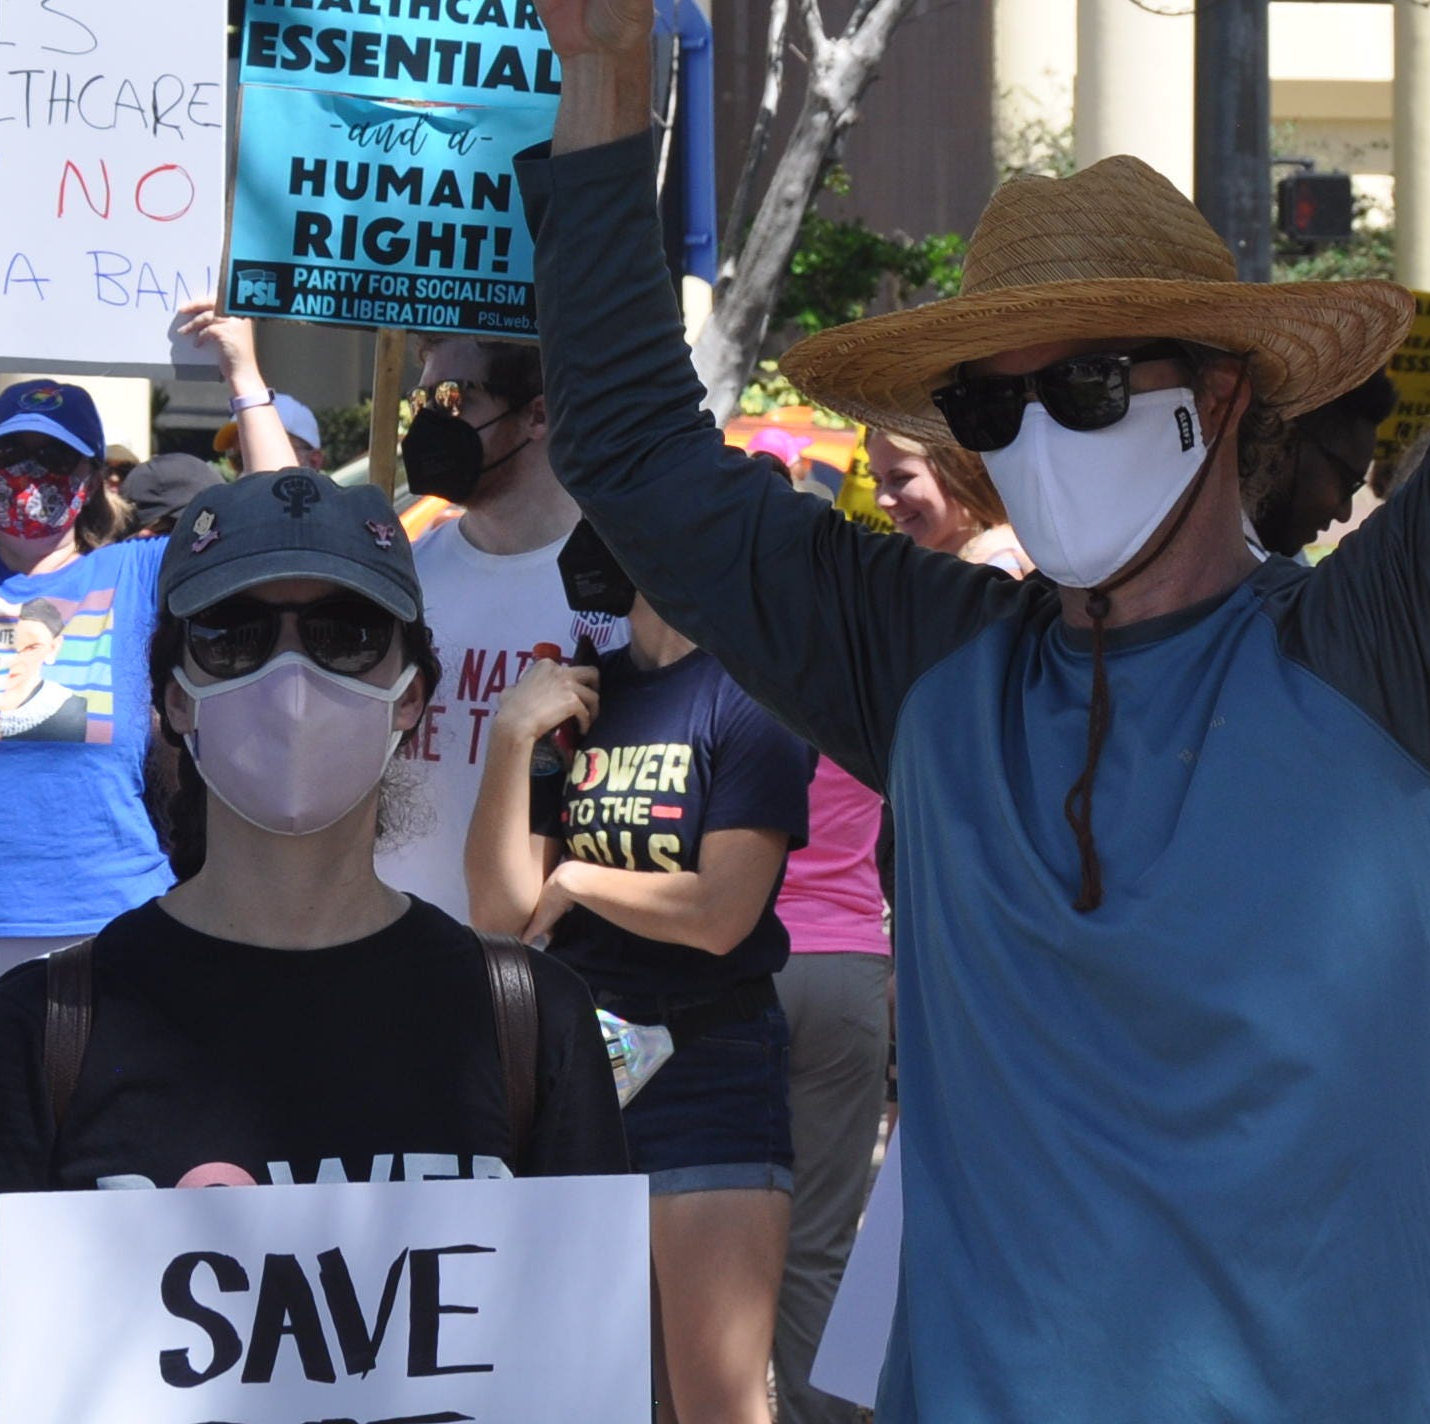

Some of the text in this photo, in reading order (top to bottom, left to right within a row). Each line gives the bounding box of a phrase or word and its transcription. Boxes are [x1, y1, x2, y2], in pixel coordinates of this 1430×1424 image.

[246, 21, 561, 95] ESSENTIAL
[58, 158, 195, 222] NO
[289, 156, 511, 212] HUMAN
[292, 210, 512, 273] RIGHT!
[4, 253, 51, 300] A
[237, 280, 281, 307] PSL
[293, 267, 526, 306] PARTY FOR SOCIALISM
[290, 293, 460, 326] AND LIBERATION
[568, 797, 652, 826] TO THE
[159, 1243, 497, 1389] SAVE
